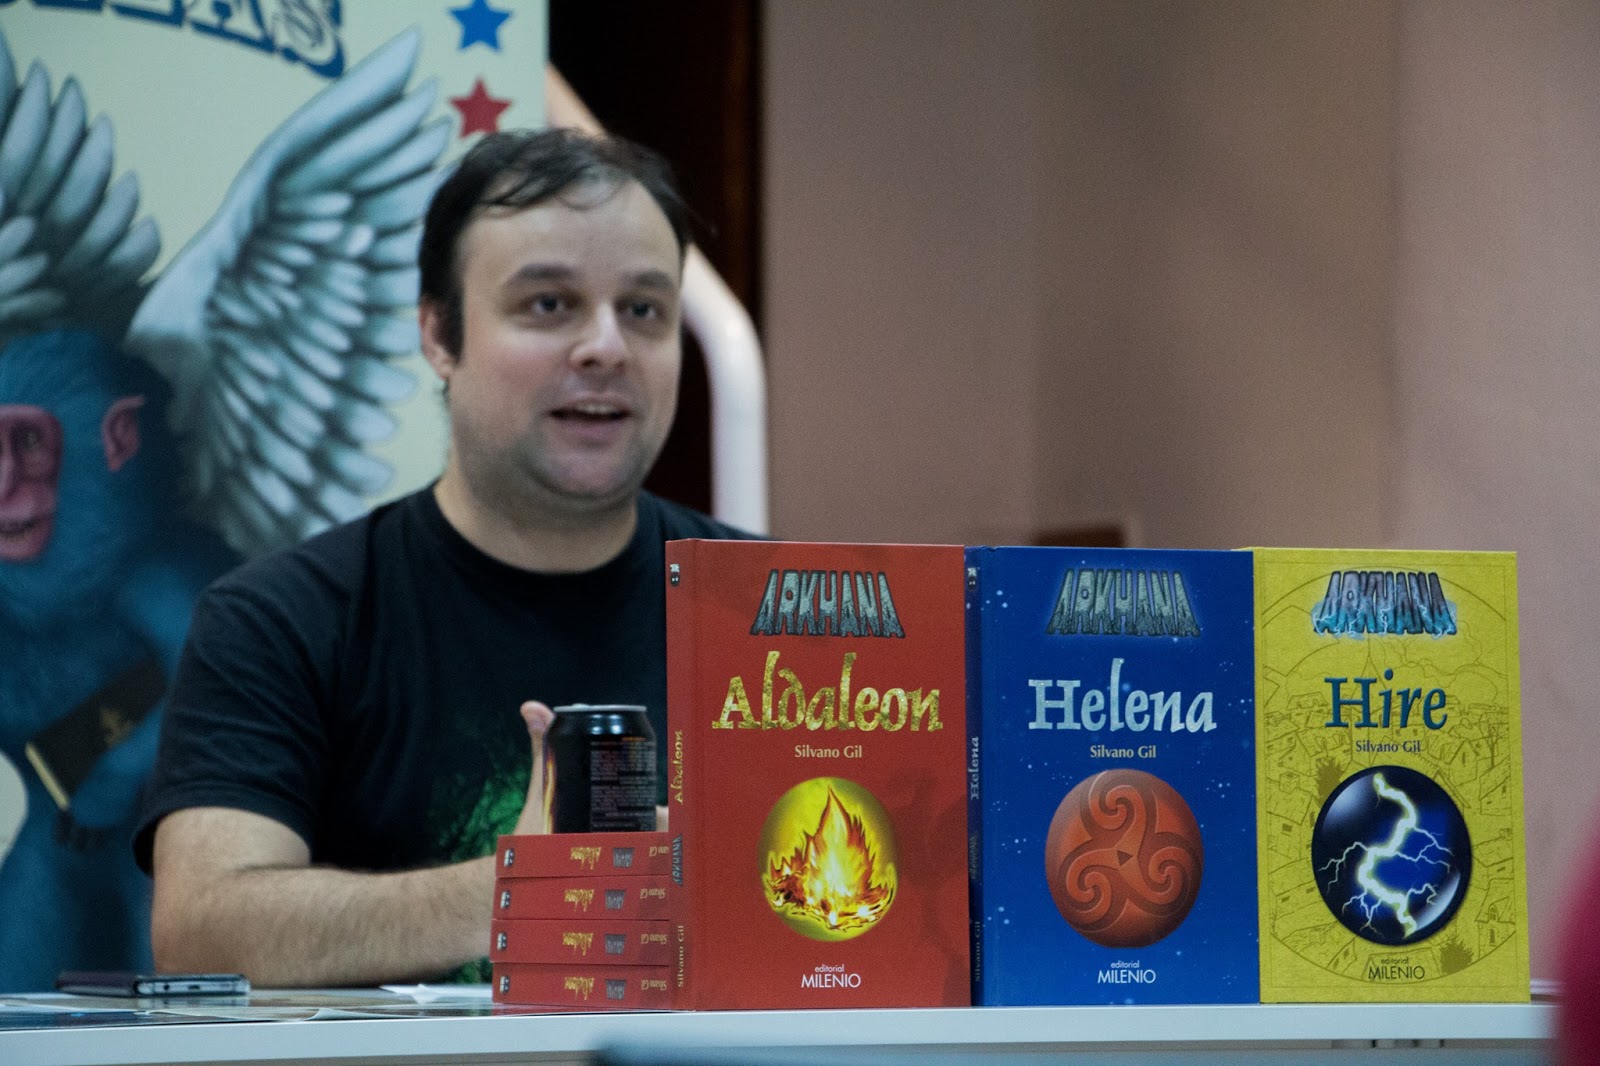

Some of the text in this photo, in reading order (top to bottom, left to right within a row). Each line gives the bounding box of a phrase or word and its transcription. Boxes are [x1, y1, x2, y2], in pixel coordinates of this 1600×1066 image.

[750, 569, 906, 638] ARKHANA
[1047, 568, 1201, 637] ARKHANA
[1313, 570, 1457, 636] ARKHANA
[712, 650, 943, 732] Aldaleon
[1028, 658, 1217, 733] Helena
[1324, 668, 1448, 730] Hire
[794, 745, 863, 758] Silvano Gil
[1090, 745, 1157, 758] Silvano Gil
[1355, 740, 1421, 753] Silvano Gil
[967, 736, 979, 800] Helena
[814, 964, 845, 973] editorial
[1110, 960, 1140, 969] editorial
[1097, 969, 1157, 983] MILENIO
[1368, 965, 1425, 979] MILENIO
[801, 974, 862, 988] MILENIO
